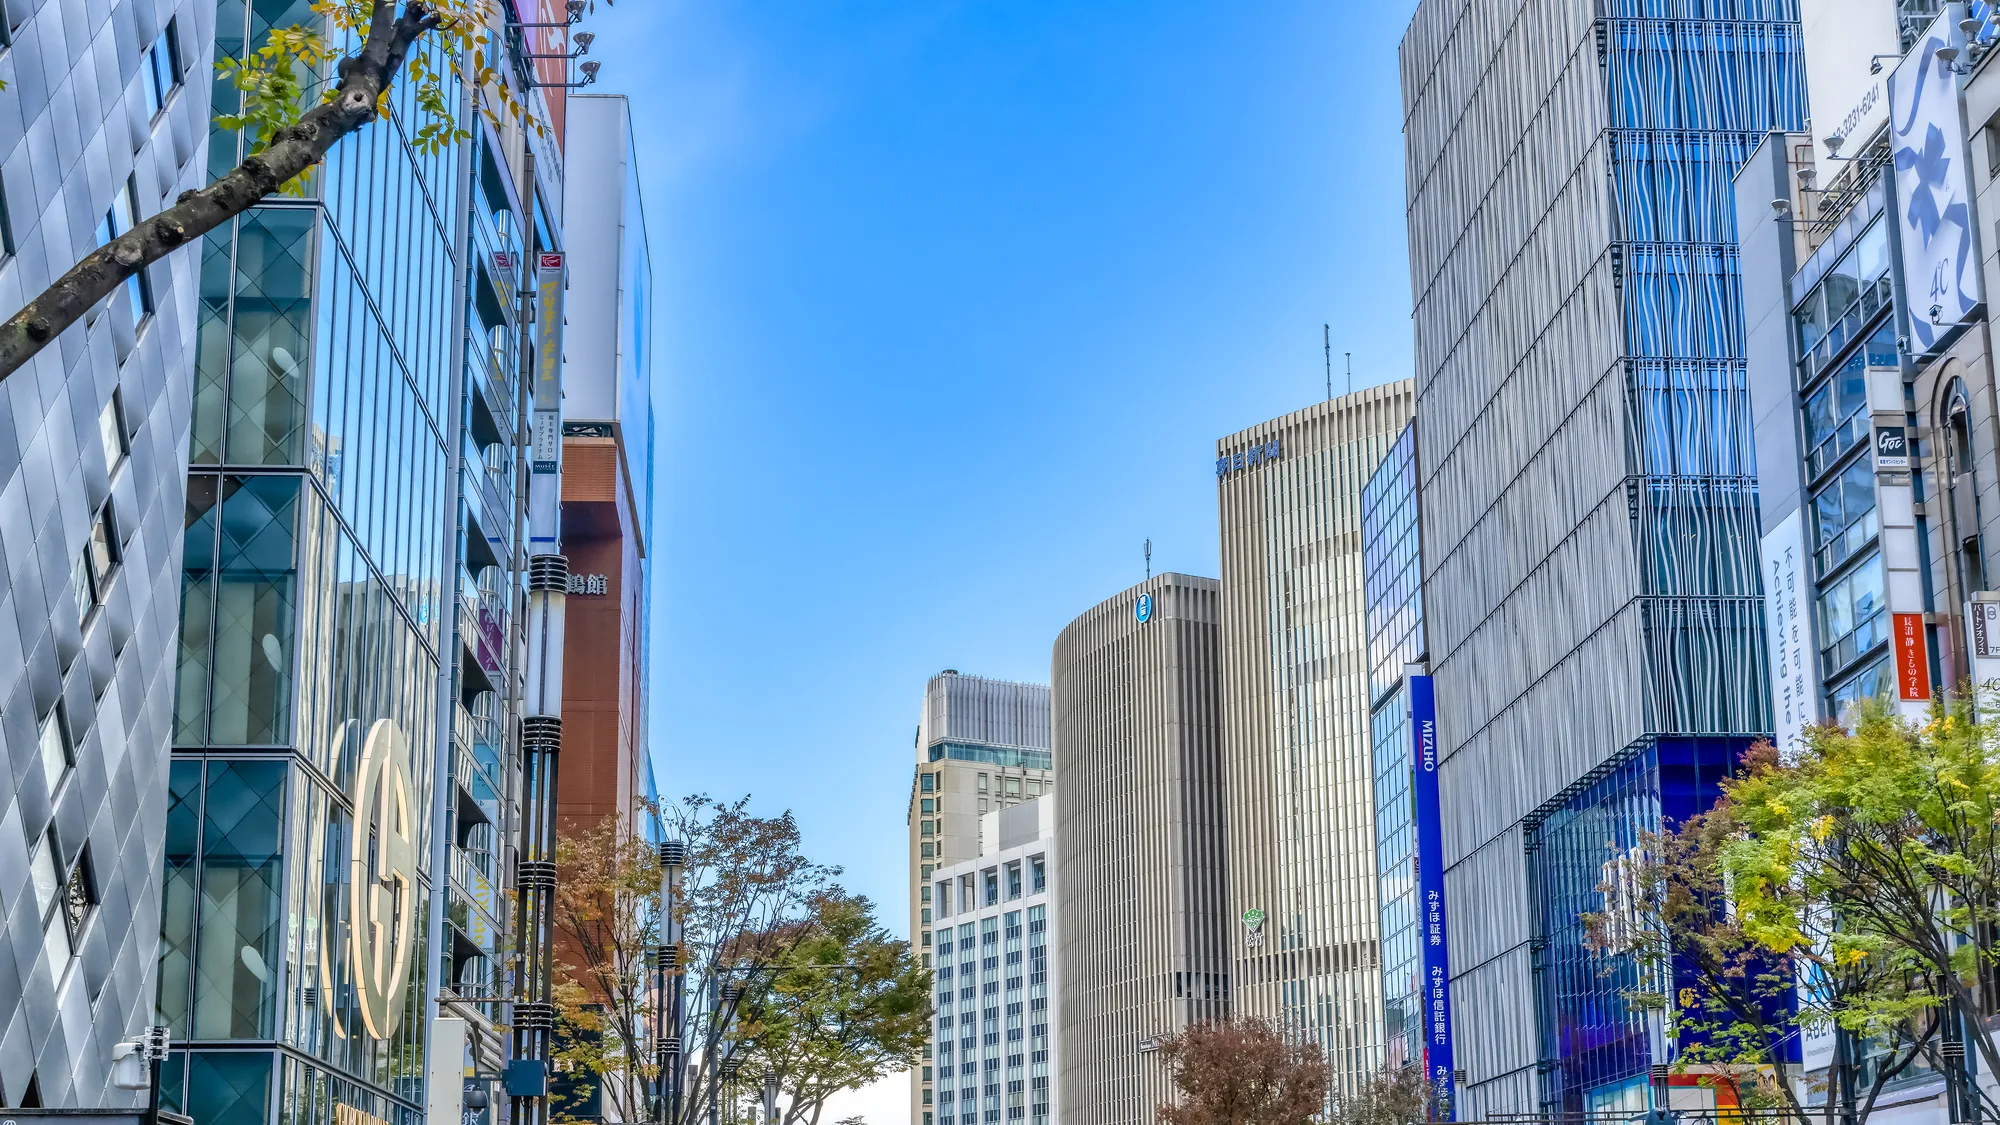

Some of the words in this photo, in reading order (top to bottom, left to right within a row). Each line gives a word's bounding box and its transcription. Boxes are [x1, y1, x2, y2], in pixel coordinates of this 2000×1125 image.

[1216, 439, 1279, 479] 朝日新聞
[1772, 559, 1788, 679] Achieving
[1783, 685, 1791, 725] the
[1422, 720, 1435, 772] MIZUHO
[1428, 890, 1441, 946] みずほ証券
[1431, 966, 1447, 1045] みずほ信託銀行
[1436, 1065, 1450, 1119] みずほ
